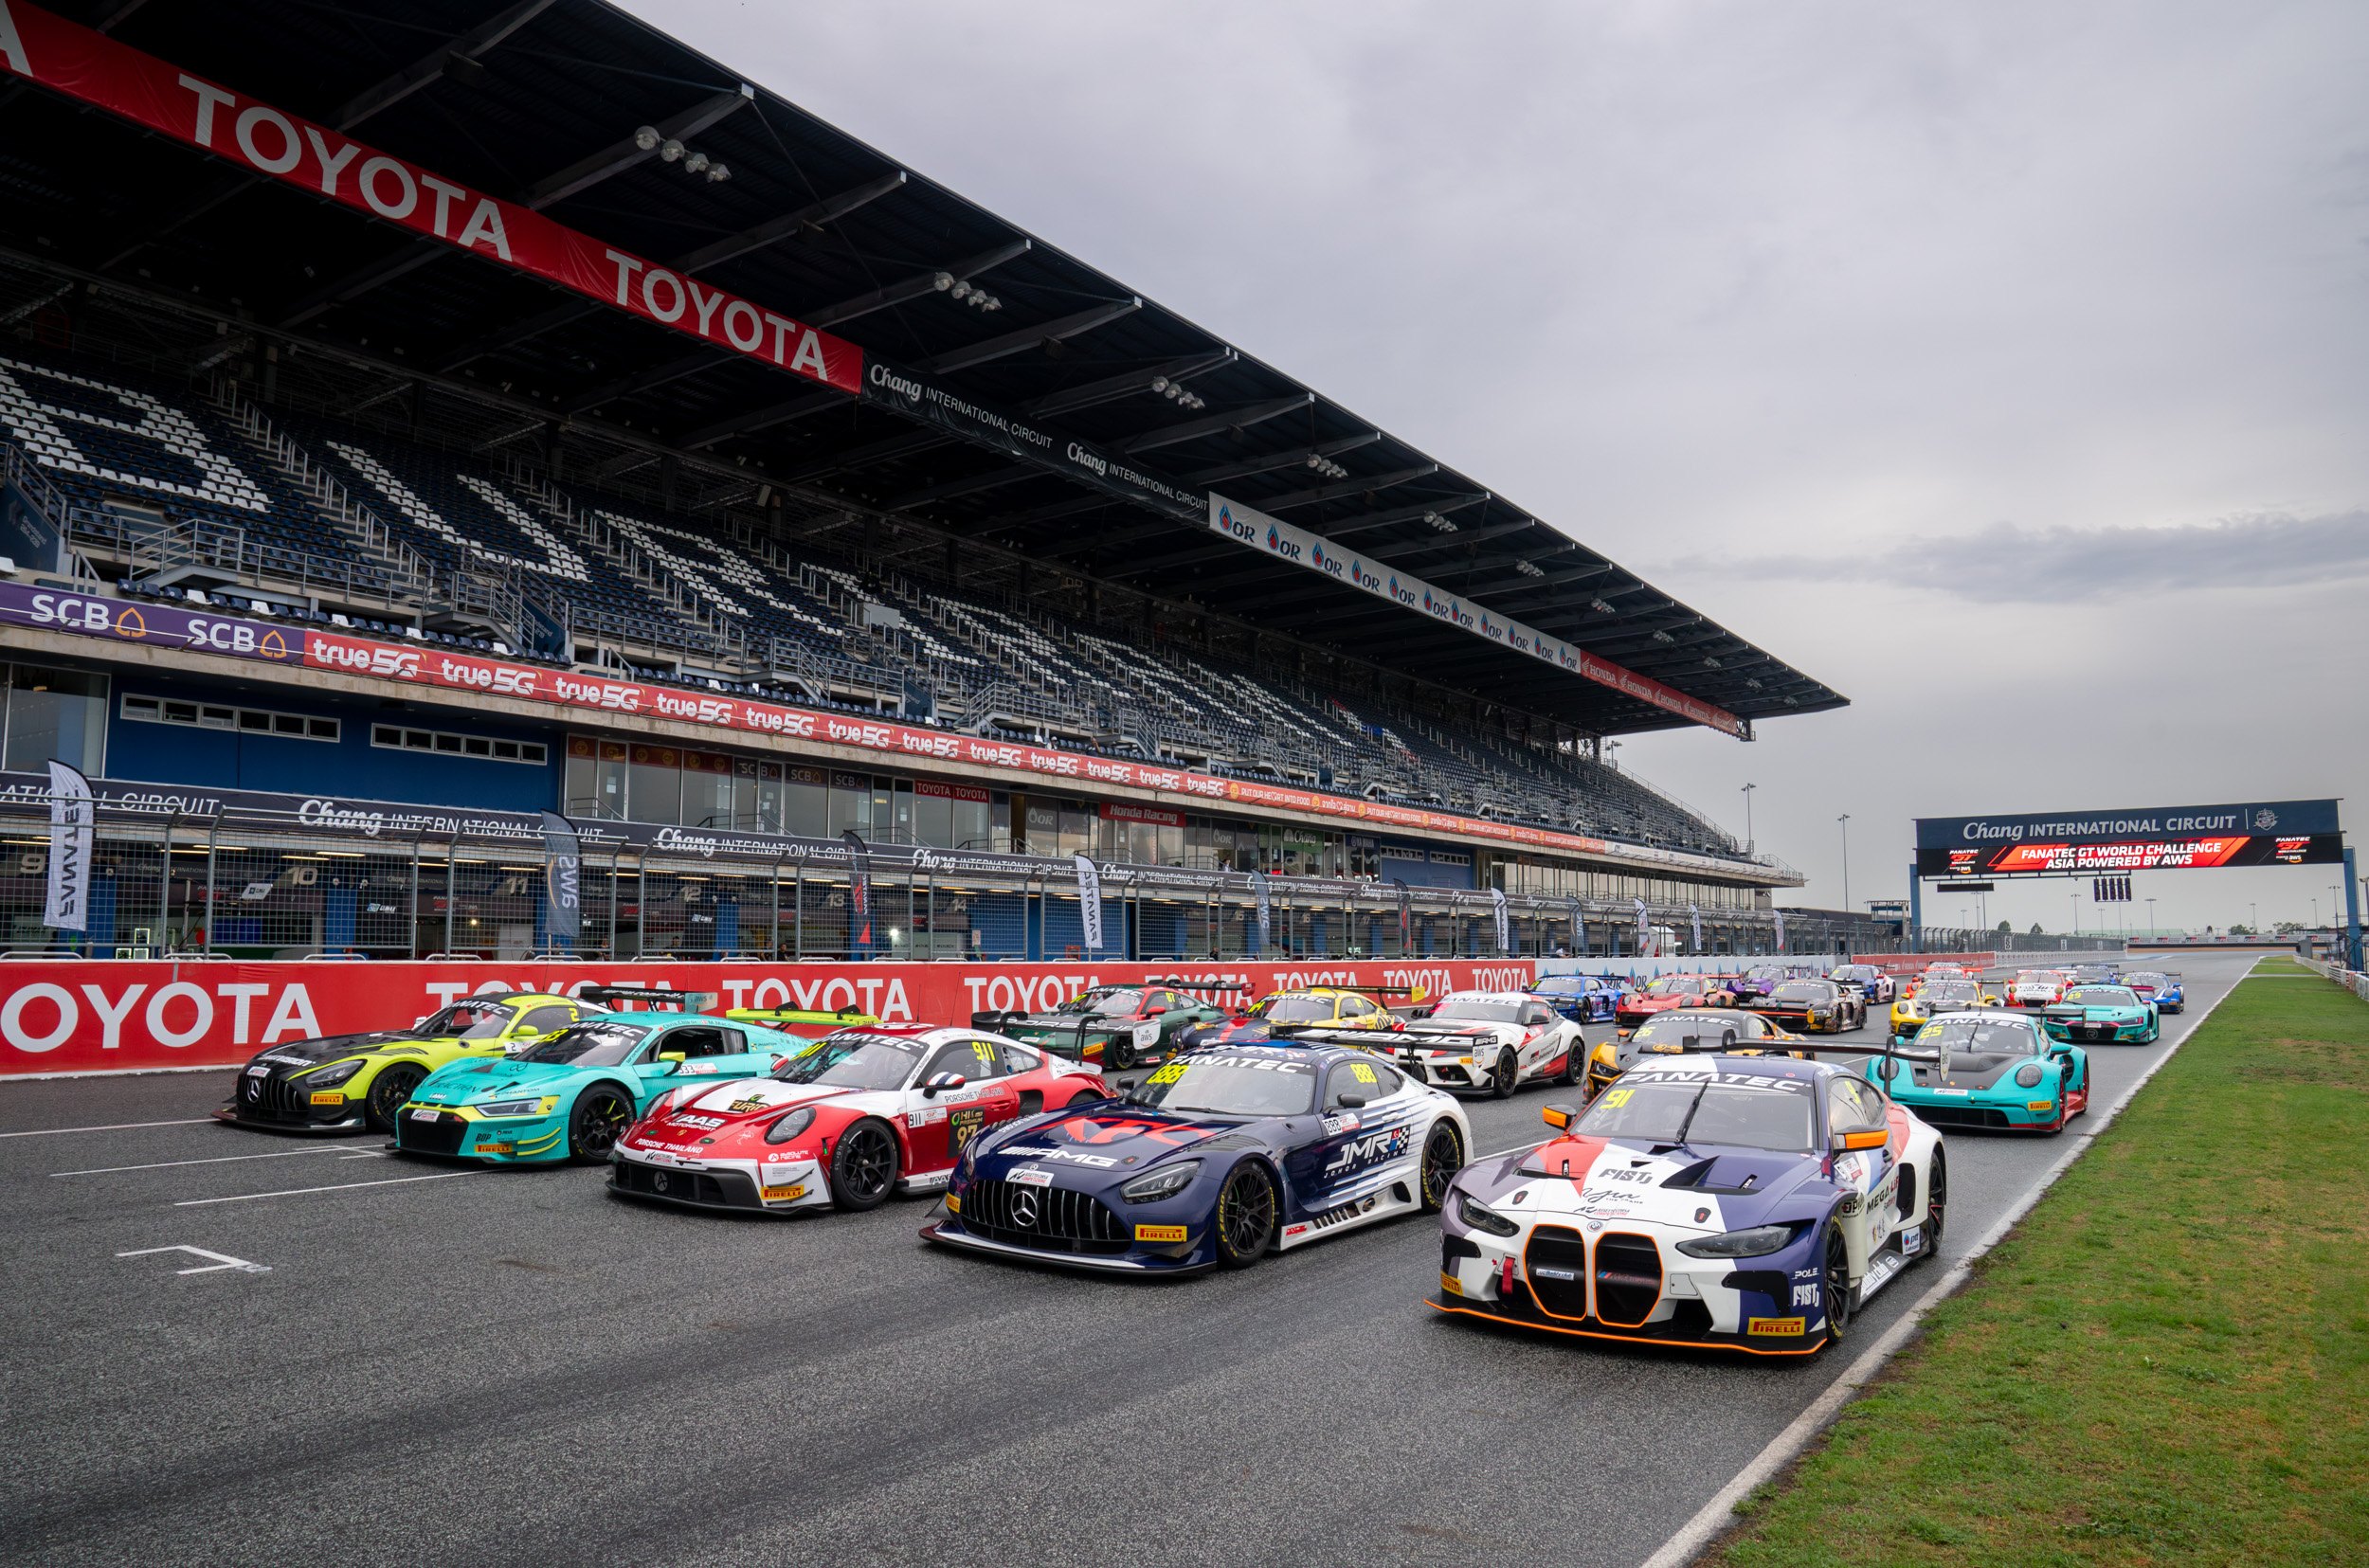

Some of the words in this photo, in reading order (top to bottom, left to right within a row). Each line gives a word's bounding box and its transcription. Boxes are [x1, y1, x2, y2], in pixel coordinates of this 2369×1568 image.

[179, 73, 513, 261] TOYOTA
[606, 248, 828, 381] TOYOTA
[871, 364, 922, 402] Chang
[926, 387, 1008, 432] INTERNATIONAL
[1011, 423, 1053, 449] CIRCUIT
[1067, 442, 1107, 476] Chang
[1109, 462, 1174, 499] INTERNATIONAL
[1176, 490, 1208, 511] CIRCUIT
[1233, 522, 1256, 543] OR
[1279, 541, 1300, 561] OR
[1324, 558, 1343, 578] OR
[1362, 574, 1380, 593] OR
[1399, 589, 1416, 607] OR
[31, 594, 109, 631] SCB
[1433, 603, 1449, 620] OR
[1459, 613, 1474, 629] OR
[188, 619, 255, 653] SCB
[1488, 626, 1502, 640] OR
[1515, 636, 1528, 651] OR
[1541, 647, 1553, 661] OR
[1566, 657, 1578, 671] OR
[1590, 664, 1617, 684] HONDA
[1627, 680, 1653, 698] HONDA
[1661, 694, 1682, 711] HONDA
[741, 763, 769, 777] SCB
[791, 769, 812, 782] SCB
[836, 775, 856, 786] SCB
[916, 782, 950, 797] TOYOTA
[955, 786, 987, 802] TOYOTA
[1253, 790, 1263, 799] OUR
[1297, 797, 1310, 805] FOOD
[121, 792, 219, 815] CIRCUIT
[298, 799, 383, 837] Chang
[390, 813, 531, 839] INTERNATIONAL
[1037, 813, 1053, 825] OR
[1111, 804, 1142, 819] Honda
[1144, 809, 1178, 824] Racing
[1962, 821, 2023, 841] Chang
[2029, 819, 2161, 838] INTERNATIONAL
[2165, 815, 2236, 832] CIRCUIT
[657, 827, 716, 857] Chang
[1294, 830, 1316, 846] Chang
[2021, 848, 2076, 859] FANATEC
[2078, 847, 2095, 857] GT
[2096, 845, 2145, 856] WORLD
[2146, 842, 2221, 856] CHALLENGE
[20, 854, 45, 874] 9
[913, 849, 956, 874] Chang
[960, 856, 1034, 874] INTERNATIONAL
[2045, 858, 2075, 869] ASIA
[2077, 856, 2141, 868] POWERED
[2143, 856, 2160, 866] BY
[2161, 855, 2193, 865] AWS
[285, 866, 318, 886] 10
[1102, 864, 1136, 885] Chang
[506, 876, 529, 894] 11
[680, 886, 702, 902] 12
[826, 892, 844, 907] 13
[950, 899, 967, 912] 14
[1383, 969, 1453, 999] TOYOTA
[1472, 967, 1528, 993] TOYOTA
[1636, 975, 1647, 988] OR
[722, 978, 913, 1027] TOYOTA
[965, 975, 1102, 1015] TOYOTA
[1166, 992, 1176, 1002] 87
[1261, 994, 1328, 1004] FANATEC
[1443, 997, 1518, 1006] FANATEC
[2067, 992, 2082, 1000] 29
[0, 982, 323, 1053] OYOTA
[569, 1007, 580, 1021] 2
[1645, 1016, 1736, 1026] FANATEC
[1633, 1026, 1656, 1038] 26
[1920, 1025, 1944, 1038] 25
[1926, 1018, 2030, 1030] FANATEC
[1140, 1033, 1152, 1041] aws
[511, 1043, 516, 1052] 2
[972, 1041, 995, 1061] 911
[1085, 1043, 1103, 1055] PIRELLI
[1474, 1047, 1485, 1057] aws
[1166, 1054, 1306, 1073] FANATEC
[1147, 1065, 1190, 1083] 888
[1350, 1064, 1377, 1083] 888
[1619, 1072, 1805, 1090] FANATEC
[945, 1090, 975, 1103] PORSCHE
[975, 1087, 1004, 1100] THAILAND
[1600, 1090, 1637, 1108] 91
[678, 1114, 727, 1127] AAS
[909, 1111, 922, 1126] 911
[1324, 1118, 1342, 1133] 888
[667, 1122, 715, 1132] MOTORSPORT
[478, 1144, 510, 1153] PIRELLI
[635, 1138, 664, 1149] PORSCHE
[665, 1143, 703, 1154] THAILAND
[1326, 1131, 1393, 1171] JMR
[1031, 1147, 1118, 1167] AMG
[1324, 1164, 1357, 1179] JOHOR
[1367, 1149, 1406, 1165] RACING
[764, 1187, 802, 1199] PIRELLI
[1867, 1185, 1890, 1215] MEGA
[1139, 1227, 1184, 1239] PIRELLI
[1794, 1268, 1818, 1279] POLE
[1752, 1320, 1800, 1334] PIRELLI
